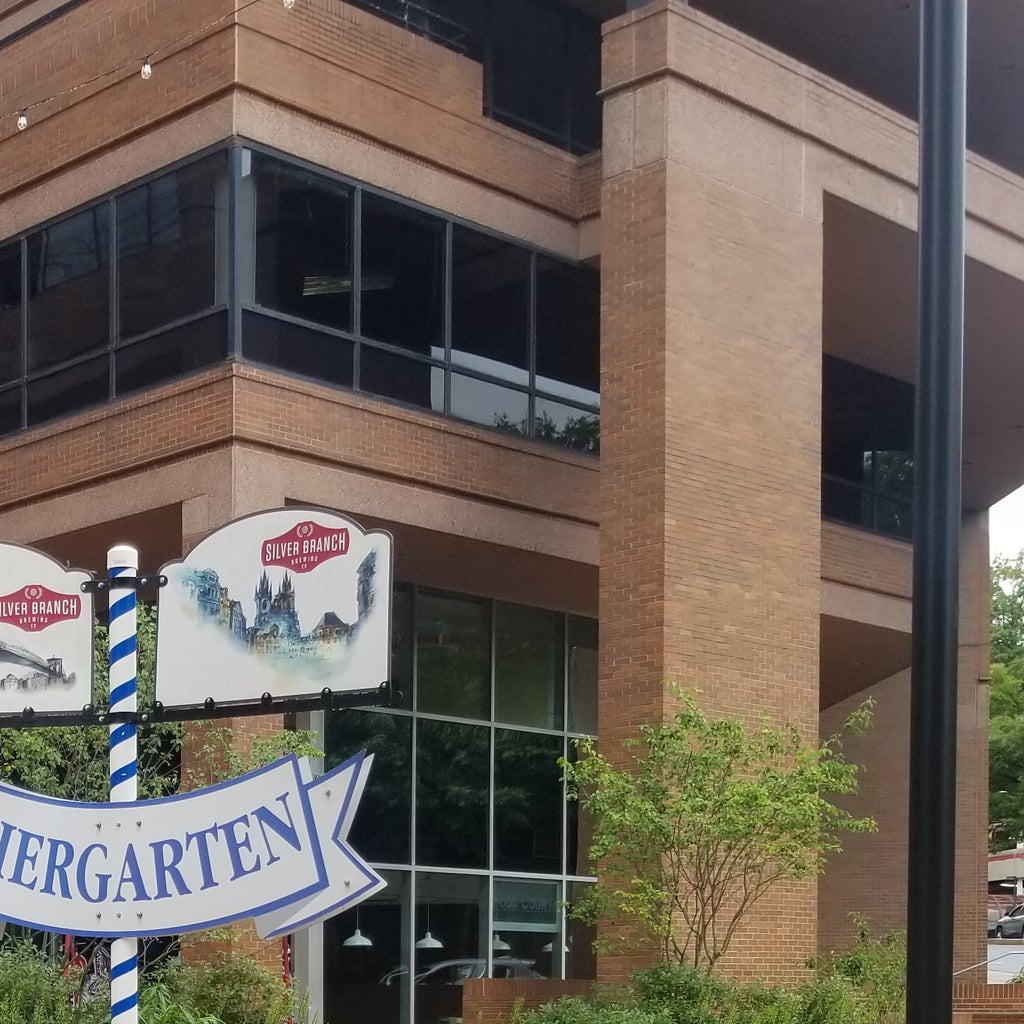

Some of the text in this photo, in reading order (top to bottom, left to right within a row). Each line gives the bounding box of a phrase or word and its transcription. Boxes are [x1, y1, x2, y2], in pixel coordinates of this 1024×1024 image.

[265, 531, 346, 562] SILVER BRANCH
[290, 556, 319, 566] BREWING
[31, 598, 77, 615] BRANCH
[19, 616, 49, 625] BREWING
